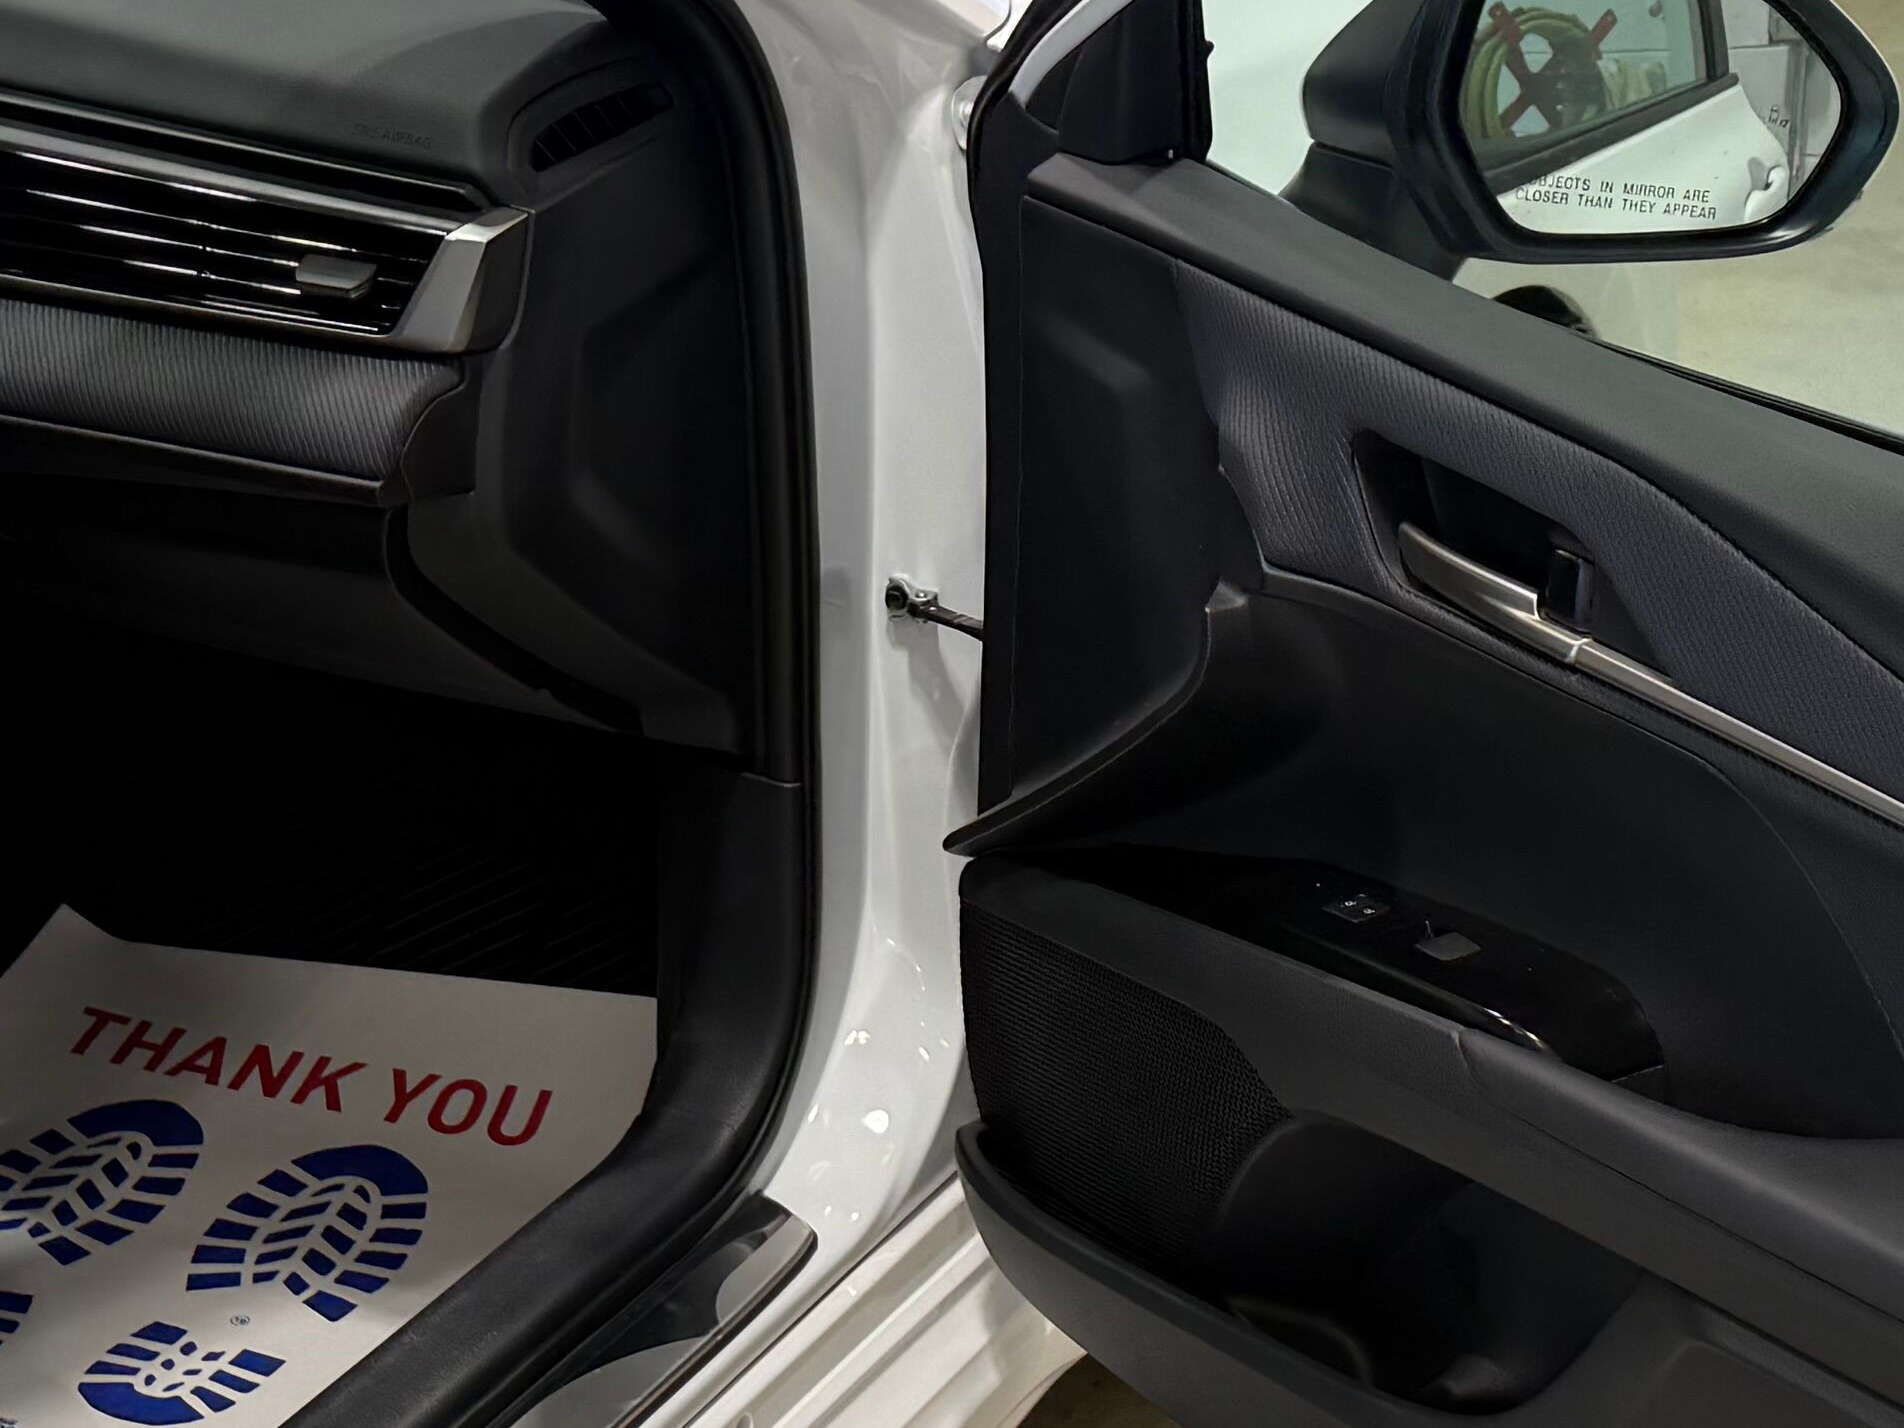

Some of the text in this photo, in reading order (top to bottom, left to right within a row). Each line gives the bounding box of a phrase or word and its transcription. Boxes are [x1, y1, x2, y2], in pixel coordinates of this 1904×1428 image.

[1515, 187, 1717, 220] CLOSER THAN THEY APPEAR
[1600, 181, 1614, 194] IN
[1623, 183, 1675, 199] MIRROR
[1683, 189, 1711, 203] ARE
[70, 1005, 553, 1147] THANK YOU
